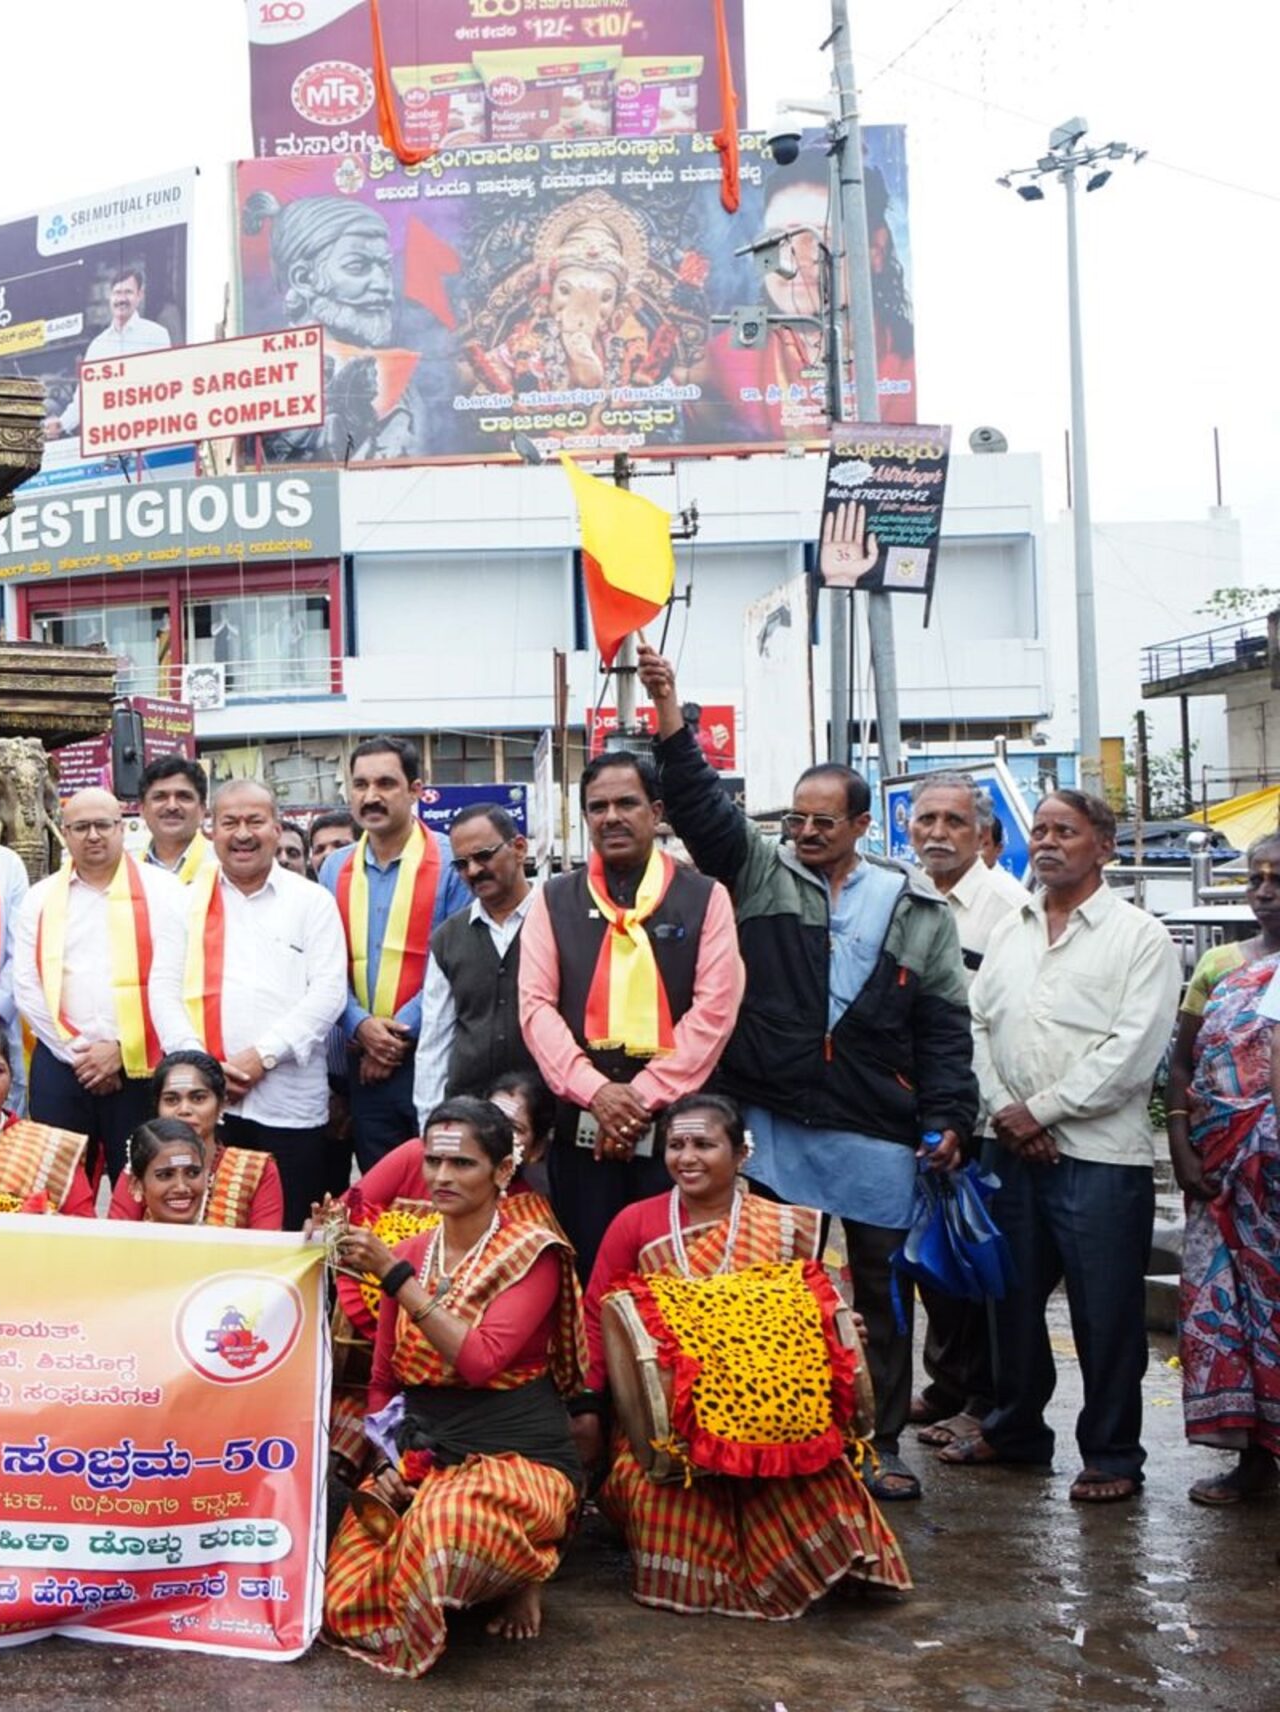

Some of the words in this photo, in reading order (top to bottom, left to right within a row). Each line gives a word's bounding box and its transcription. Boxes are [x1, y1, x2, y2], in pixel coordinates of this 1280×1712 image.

[307, 77, 359, 107] MTR
[71, 208, 90, 228] SBI
[92, 196, 143, 221] MUTUAL
[146, 186, 182, 208] FUND
[263, 331, 318, 353] K.N.D
[84, 363, 125, 381] C.S.I
[103, 380, 183, 410] BISHOP
[192, 362, 298, 397] SARGENT
[89, 412, 198, 445] SHOPPING
[208, 394, 317, 427] COMPLEX
[479, 409, 587, 432] ರಾಜಬೀದಿ
[601, 405, 675, 431] ಉತ್ಸವ
[38, 1353, 136, 1381] ಶಿವಮೊಗ್ಗ
[24, 1385, 160, 1405] ಸಂಘಟನೆಗಳ
[71, 1494, 179, 1516] ಉಸಿರಾಗಲಿ
[90, 1529, 183, 1563] ಡೊಳ್ಳು
[200, 1523, 280, 1550] ಕುಣಿತ
[153, 1571, 226, 1599] ಸಾಗರ
